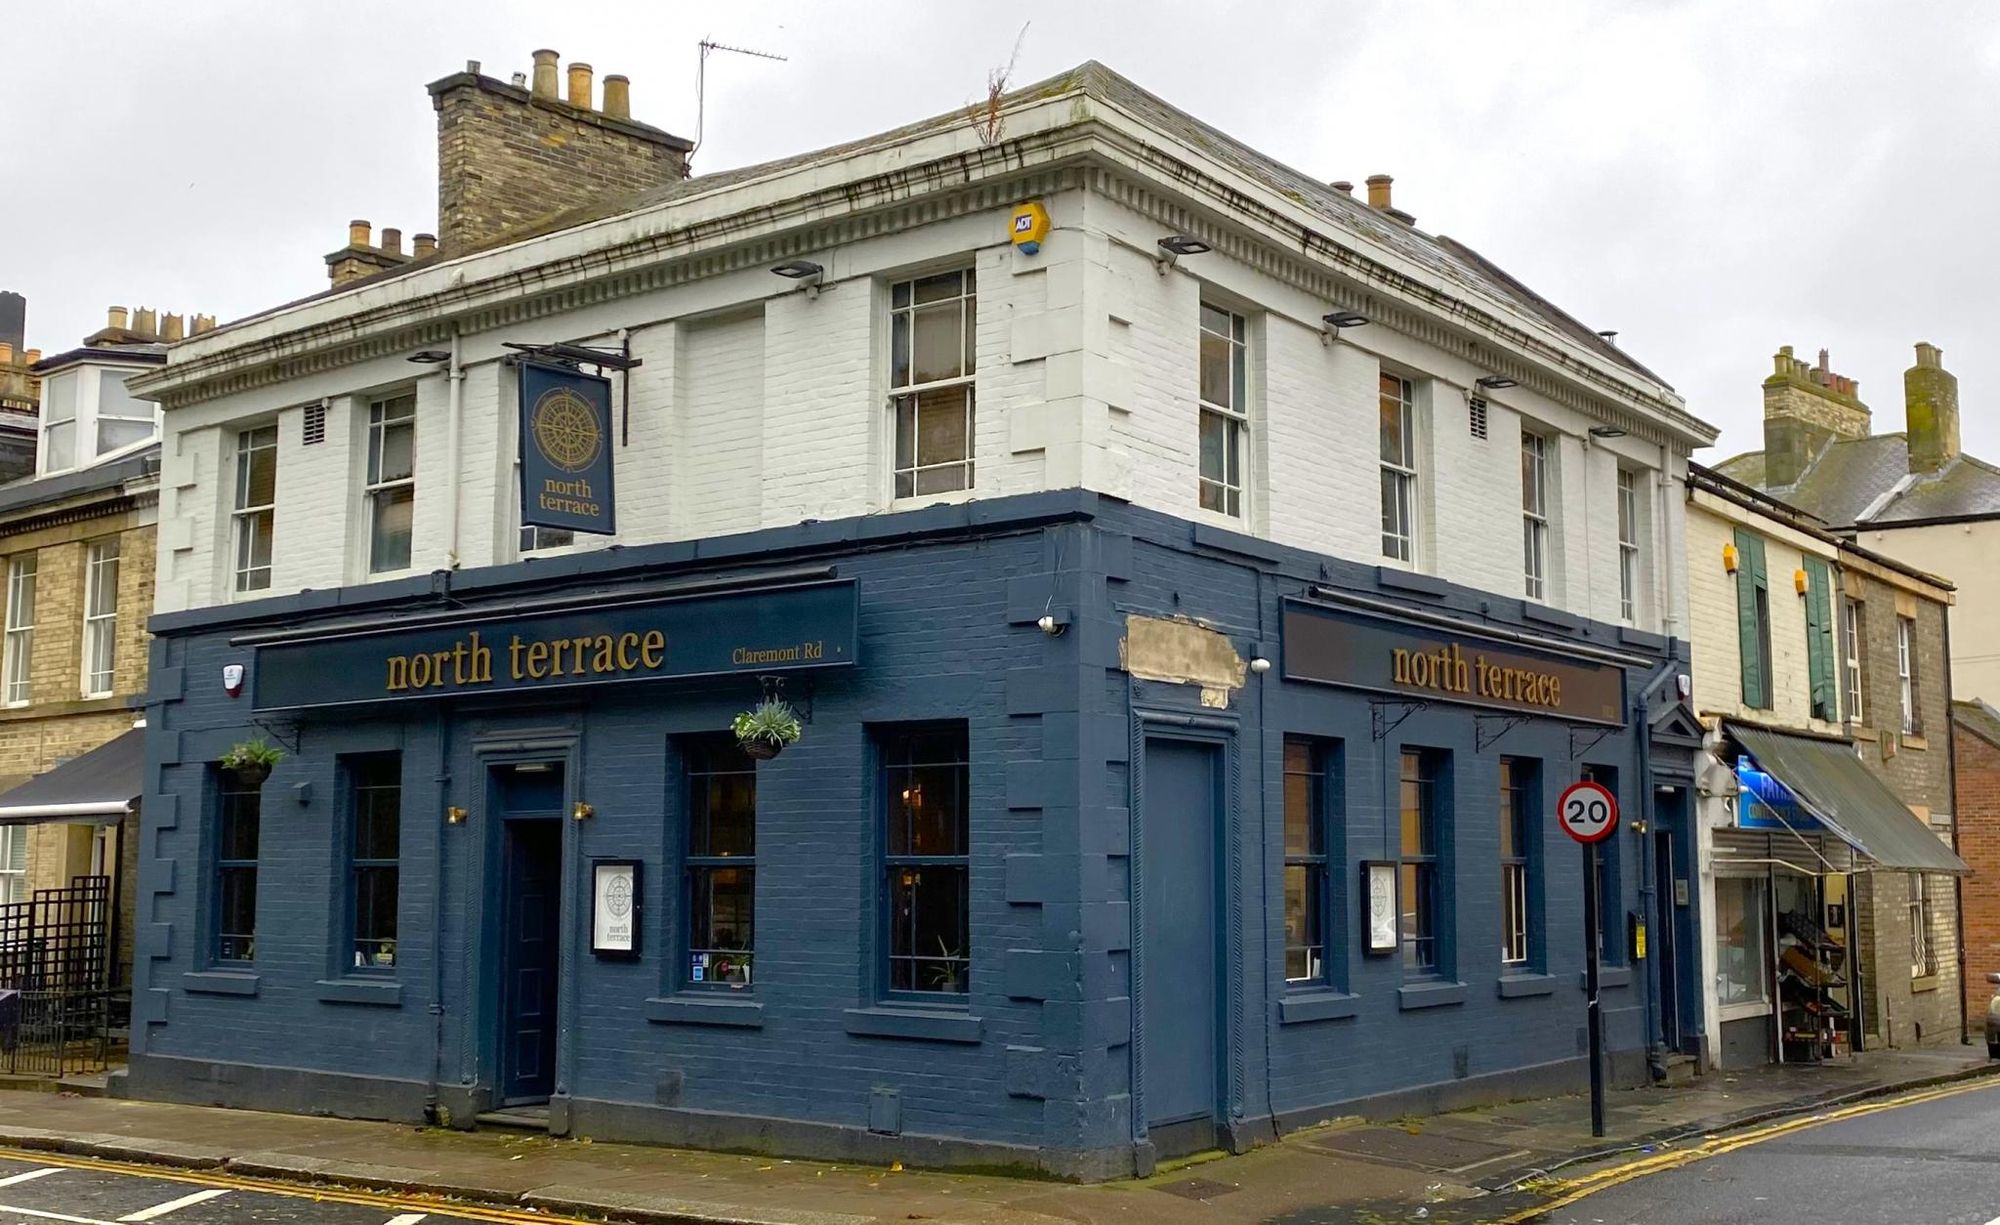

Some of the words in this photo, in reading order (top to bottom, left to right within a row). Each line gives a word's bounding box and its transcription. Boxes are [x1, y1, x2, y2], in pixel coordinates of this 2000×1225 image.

[1016, 216, 1032, 231] ADT
[544, 478, 592, 498] north
[539, 493, 599, 516] terrace
[386, 630, 494, 691] north
[509, 629, 665, 680] terrace
[732, 644, 800, 665] Claremont
[804, 640, 822, 659] Rd
[1392, 642, 1469, 693] north
[1475, 654, 1561, 708] terrace
[1567, 800, 1607, 824] 20
